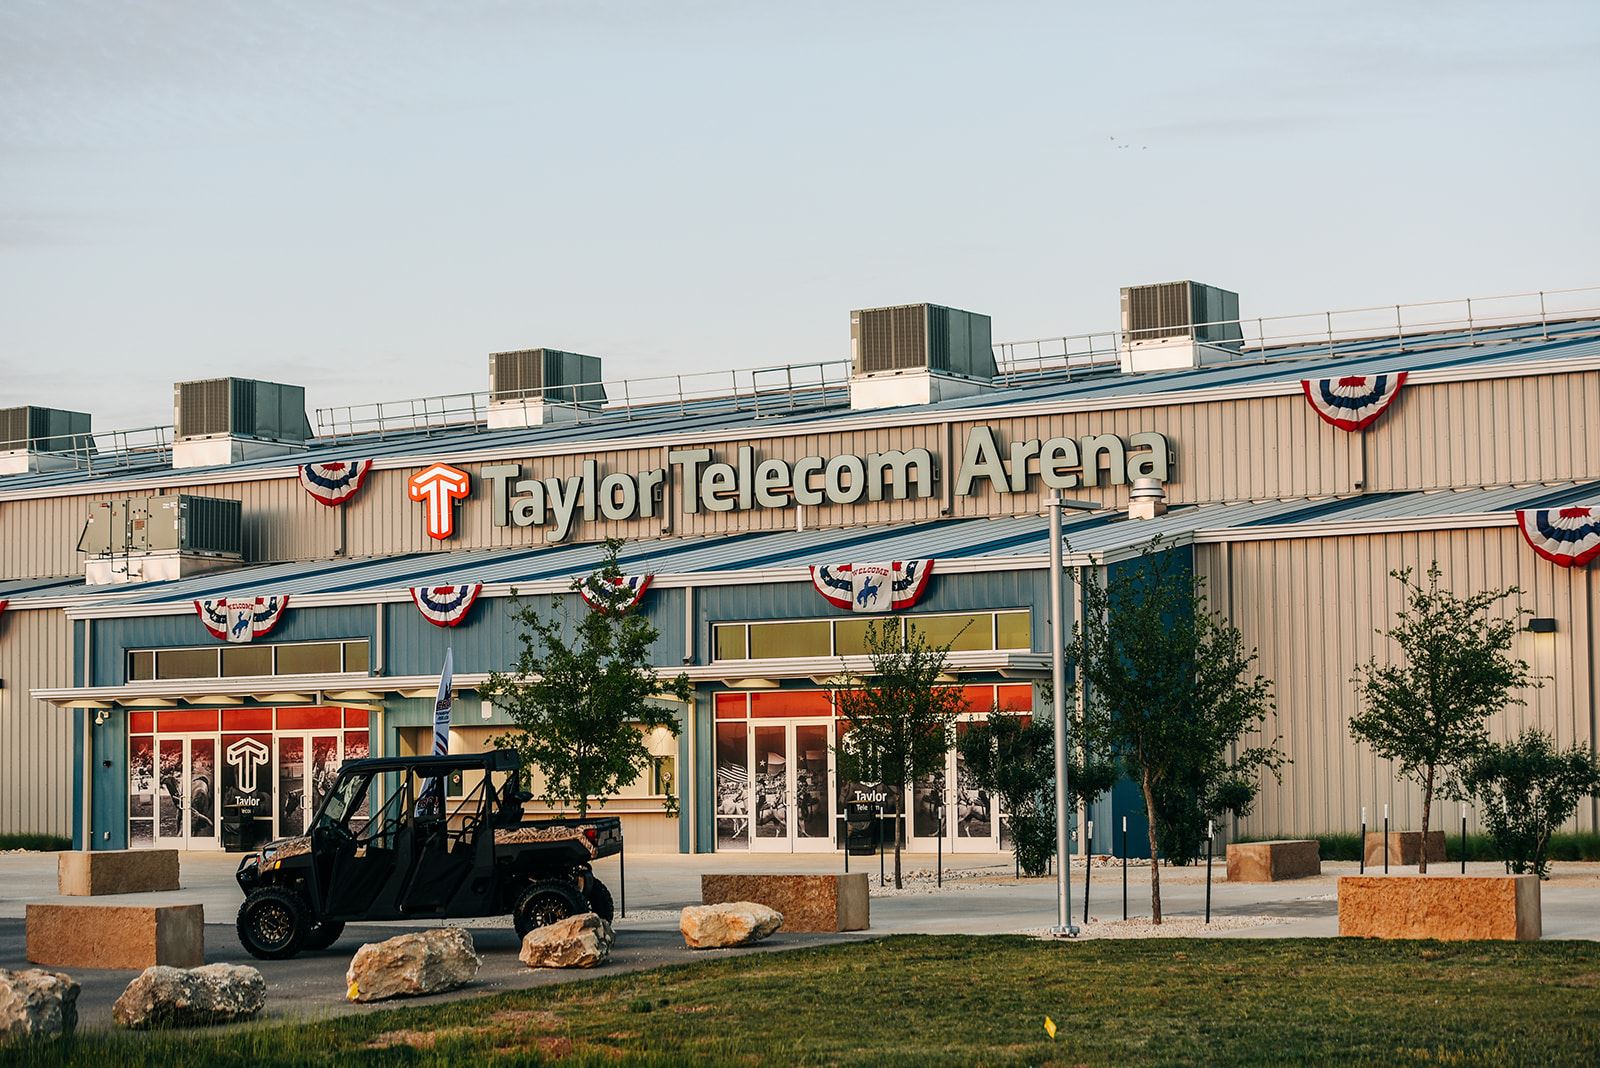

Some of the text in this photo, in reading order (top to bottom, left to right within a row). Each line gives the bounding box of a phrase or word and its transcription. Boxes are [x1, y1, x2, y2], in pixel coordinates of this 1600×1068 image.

[481, 425, 1172, 542] Taylor Telecom Arena
[852, 567, 889, 576] WELCOME
